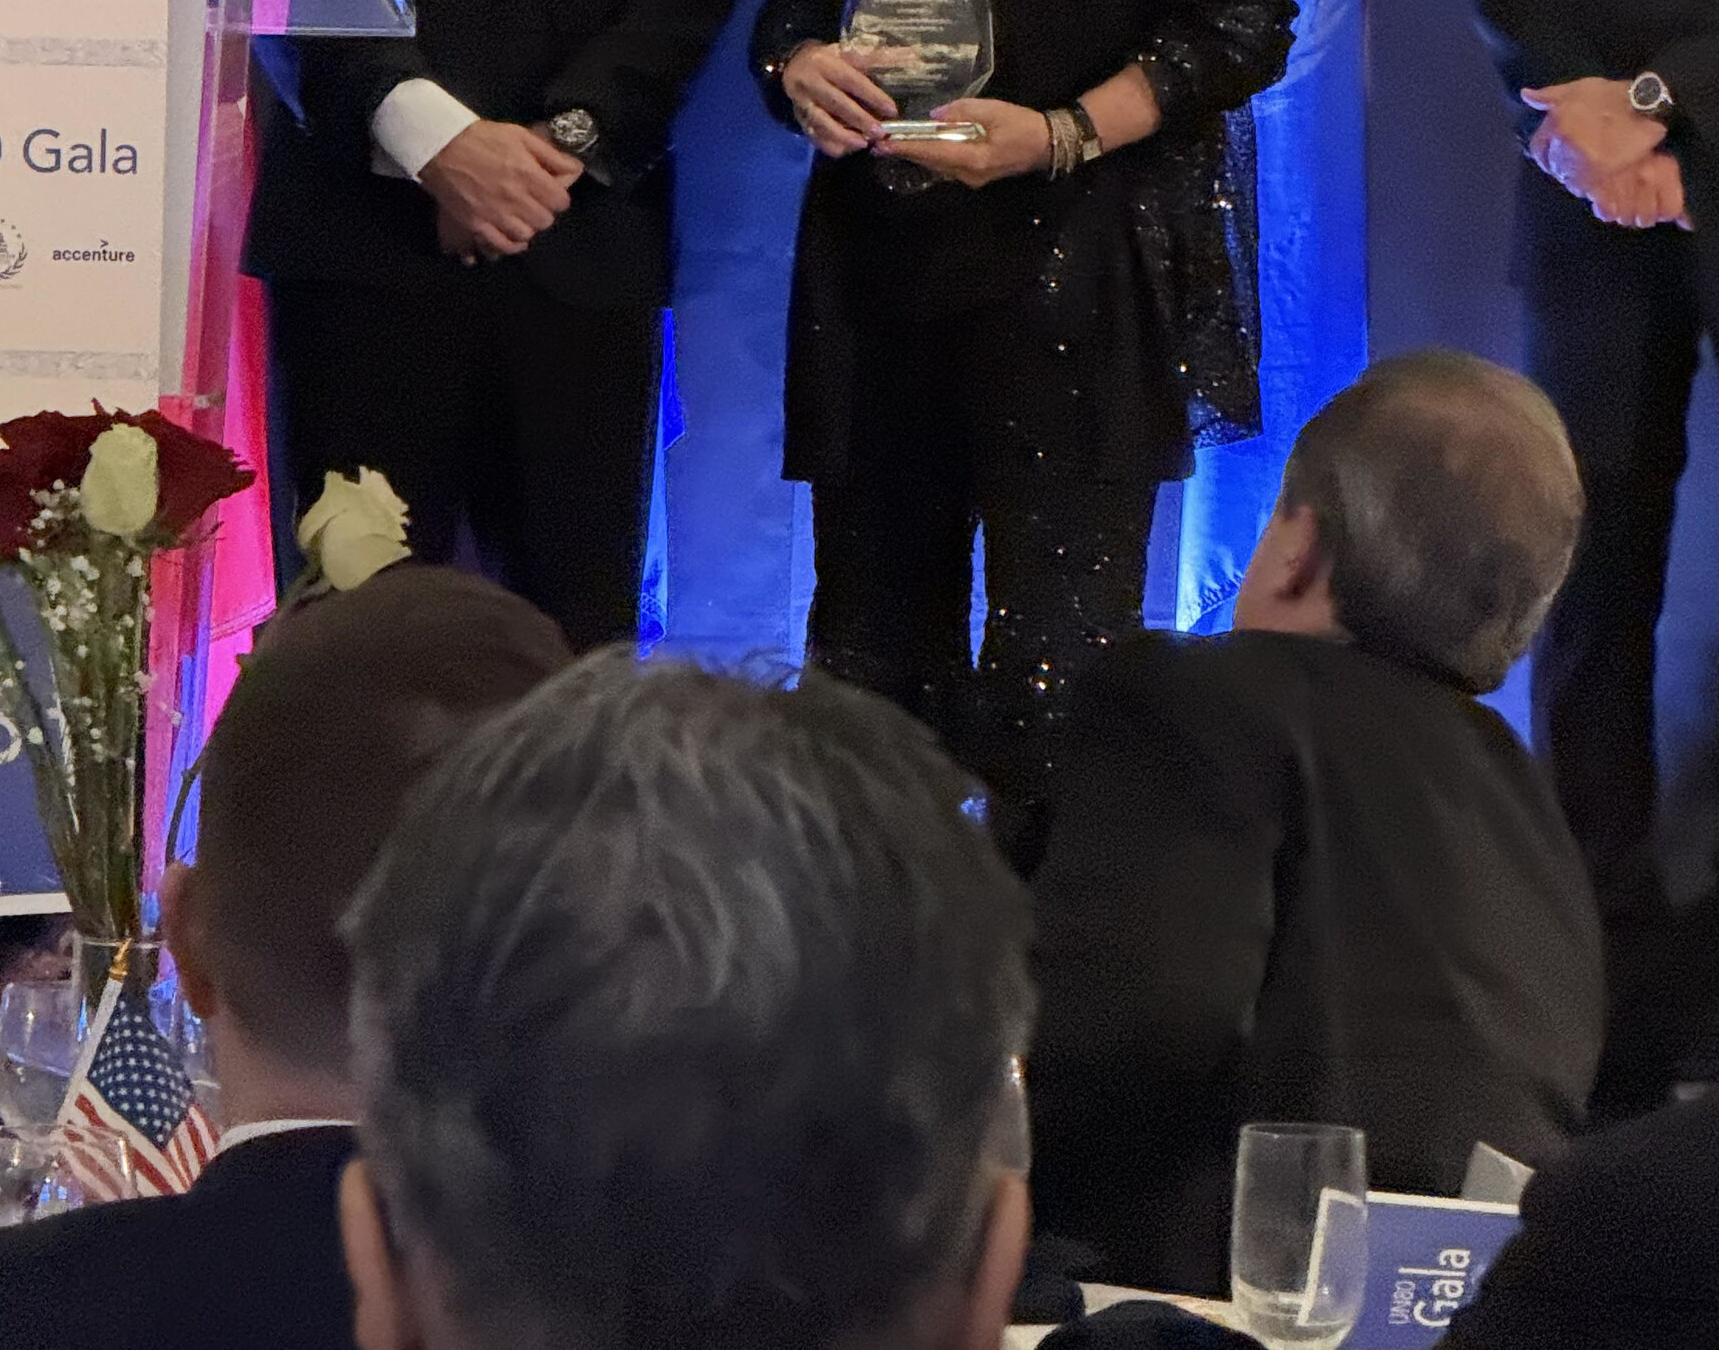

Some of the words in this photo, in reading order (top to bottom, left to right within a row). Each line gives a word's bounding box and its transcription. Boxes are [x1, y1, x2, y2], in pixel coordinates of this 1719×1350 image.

[22, 128, 138, 175] Gala
[52, 249, 135, 262] accenture
[1388, 1280, 1416, 1325] UN80
[1398, 1249, 1471, 1327] Gala
